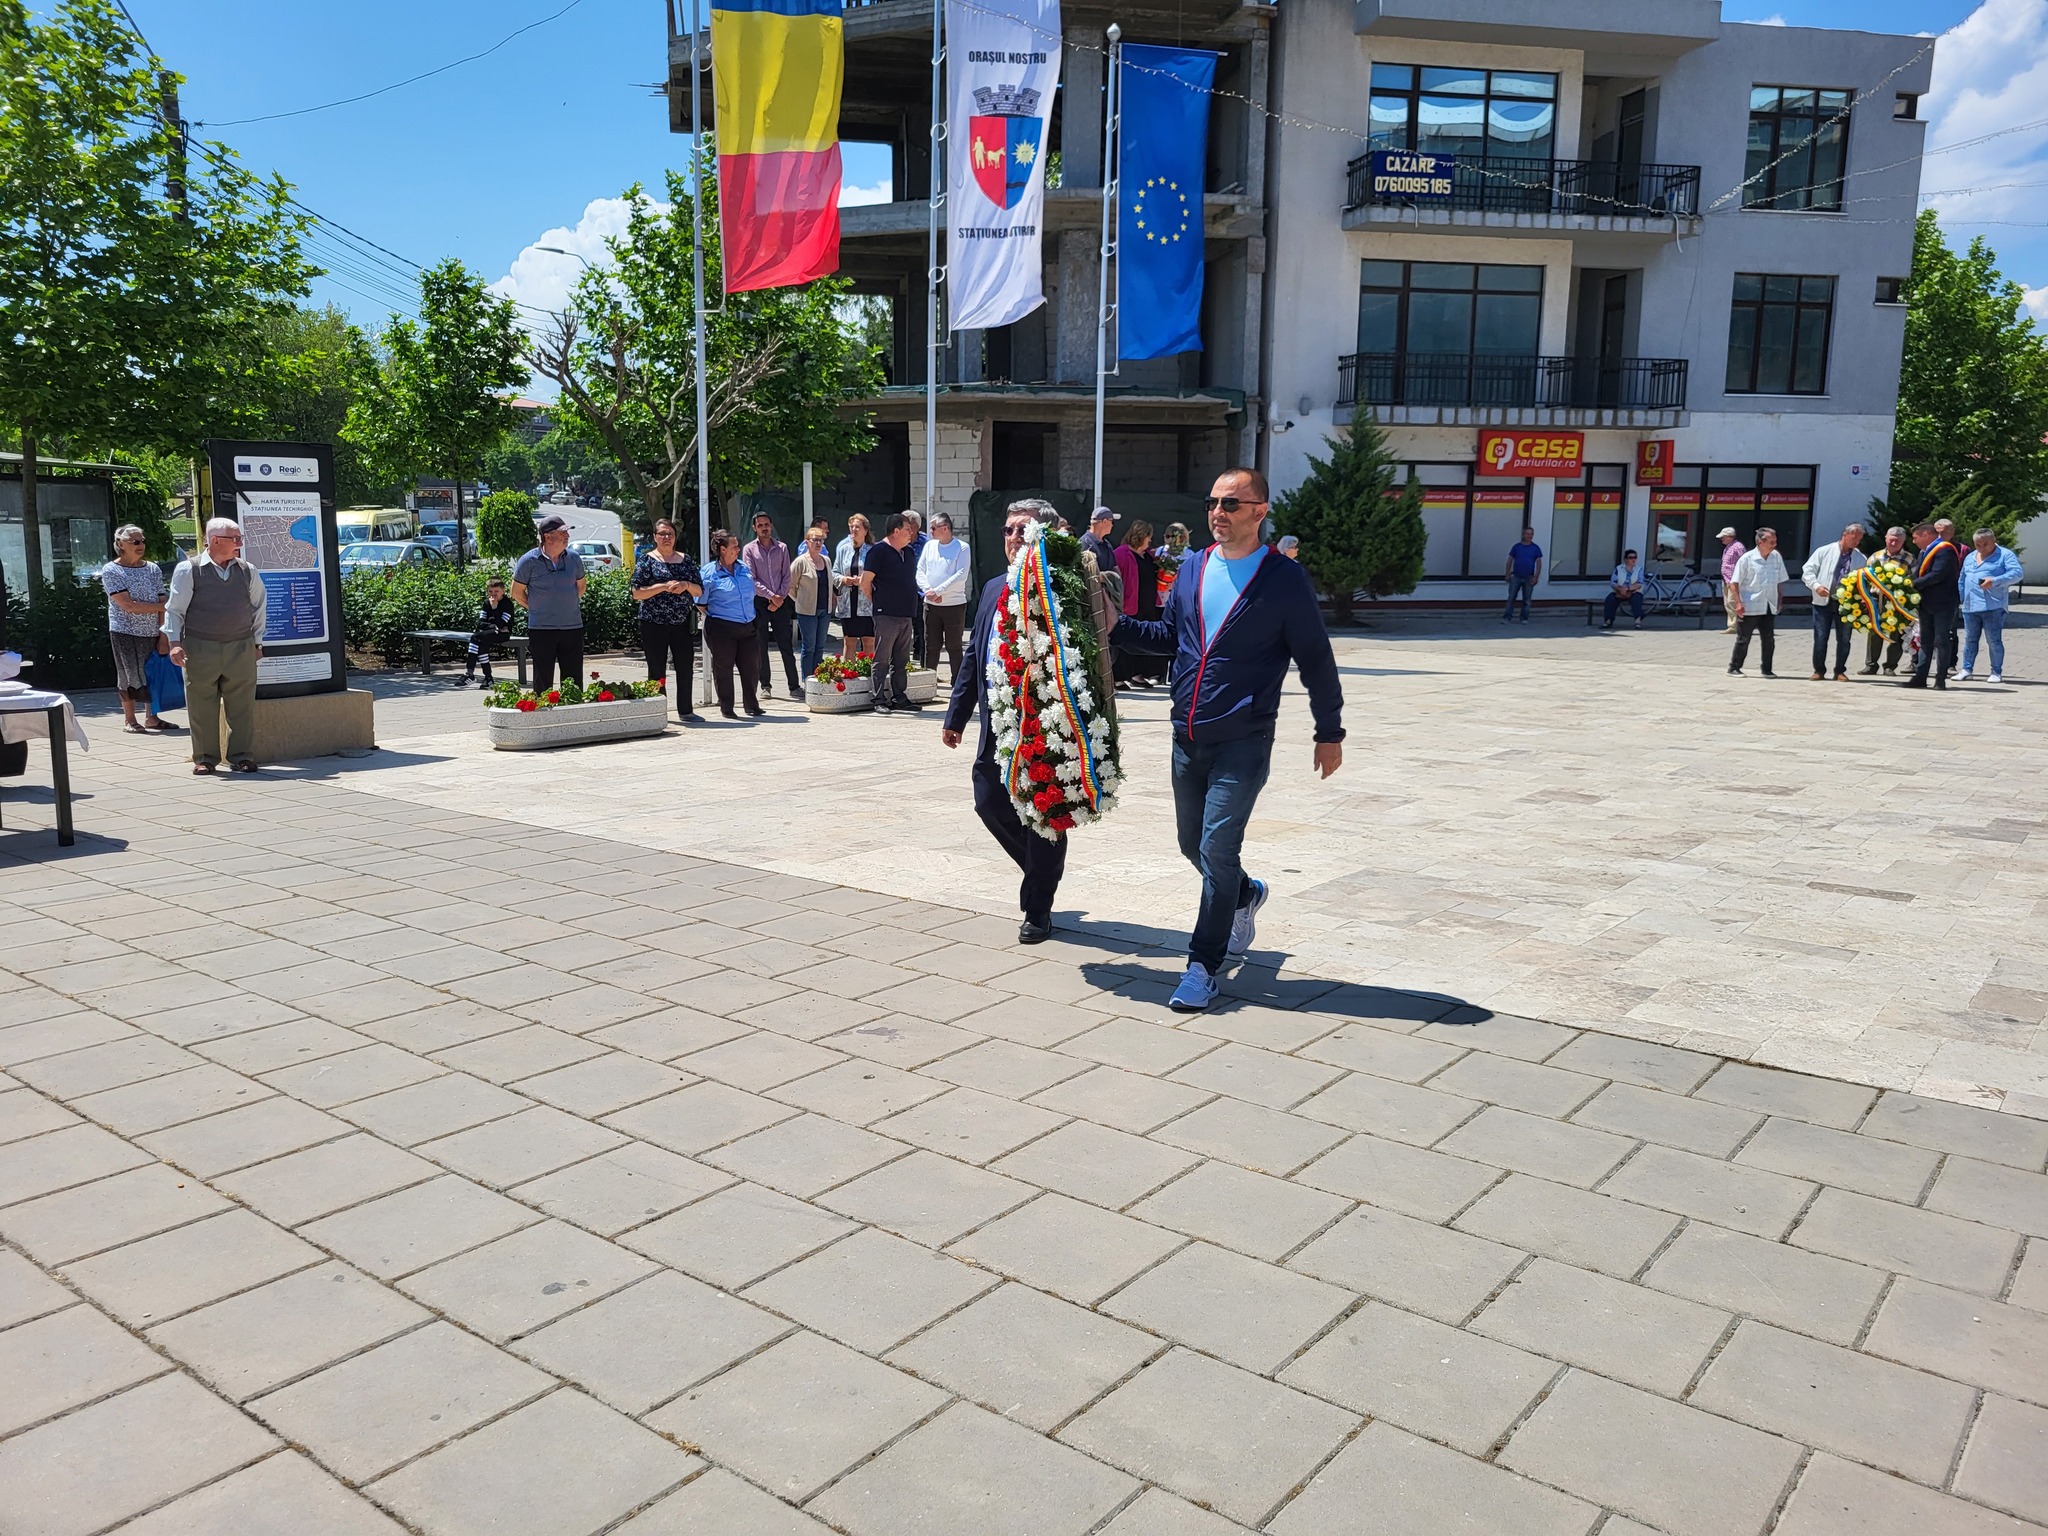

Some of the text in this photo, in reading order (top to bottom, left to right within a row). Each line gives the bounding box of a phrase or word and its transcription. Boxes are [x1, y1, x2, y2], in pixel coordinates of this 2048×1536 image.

[968, 50, 1047, 66] ORAȘUL NOSTRU
[1386, 156, 1436, 173] CAZARE
[1374, 176, 1452, 194] 0760095185
[1517, 438, 1580, 459] casa
[1513, 459, 1577, 468] pariurilor.ro
[1640, 467, 1663, 478] casa
